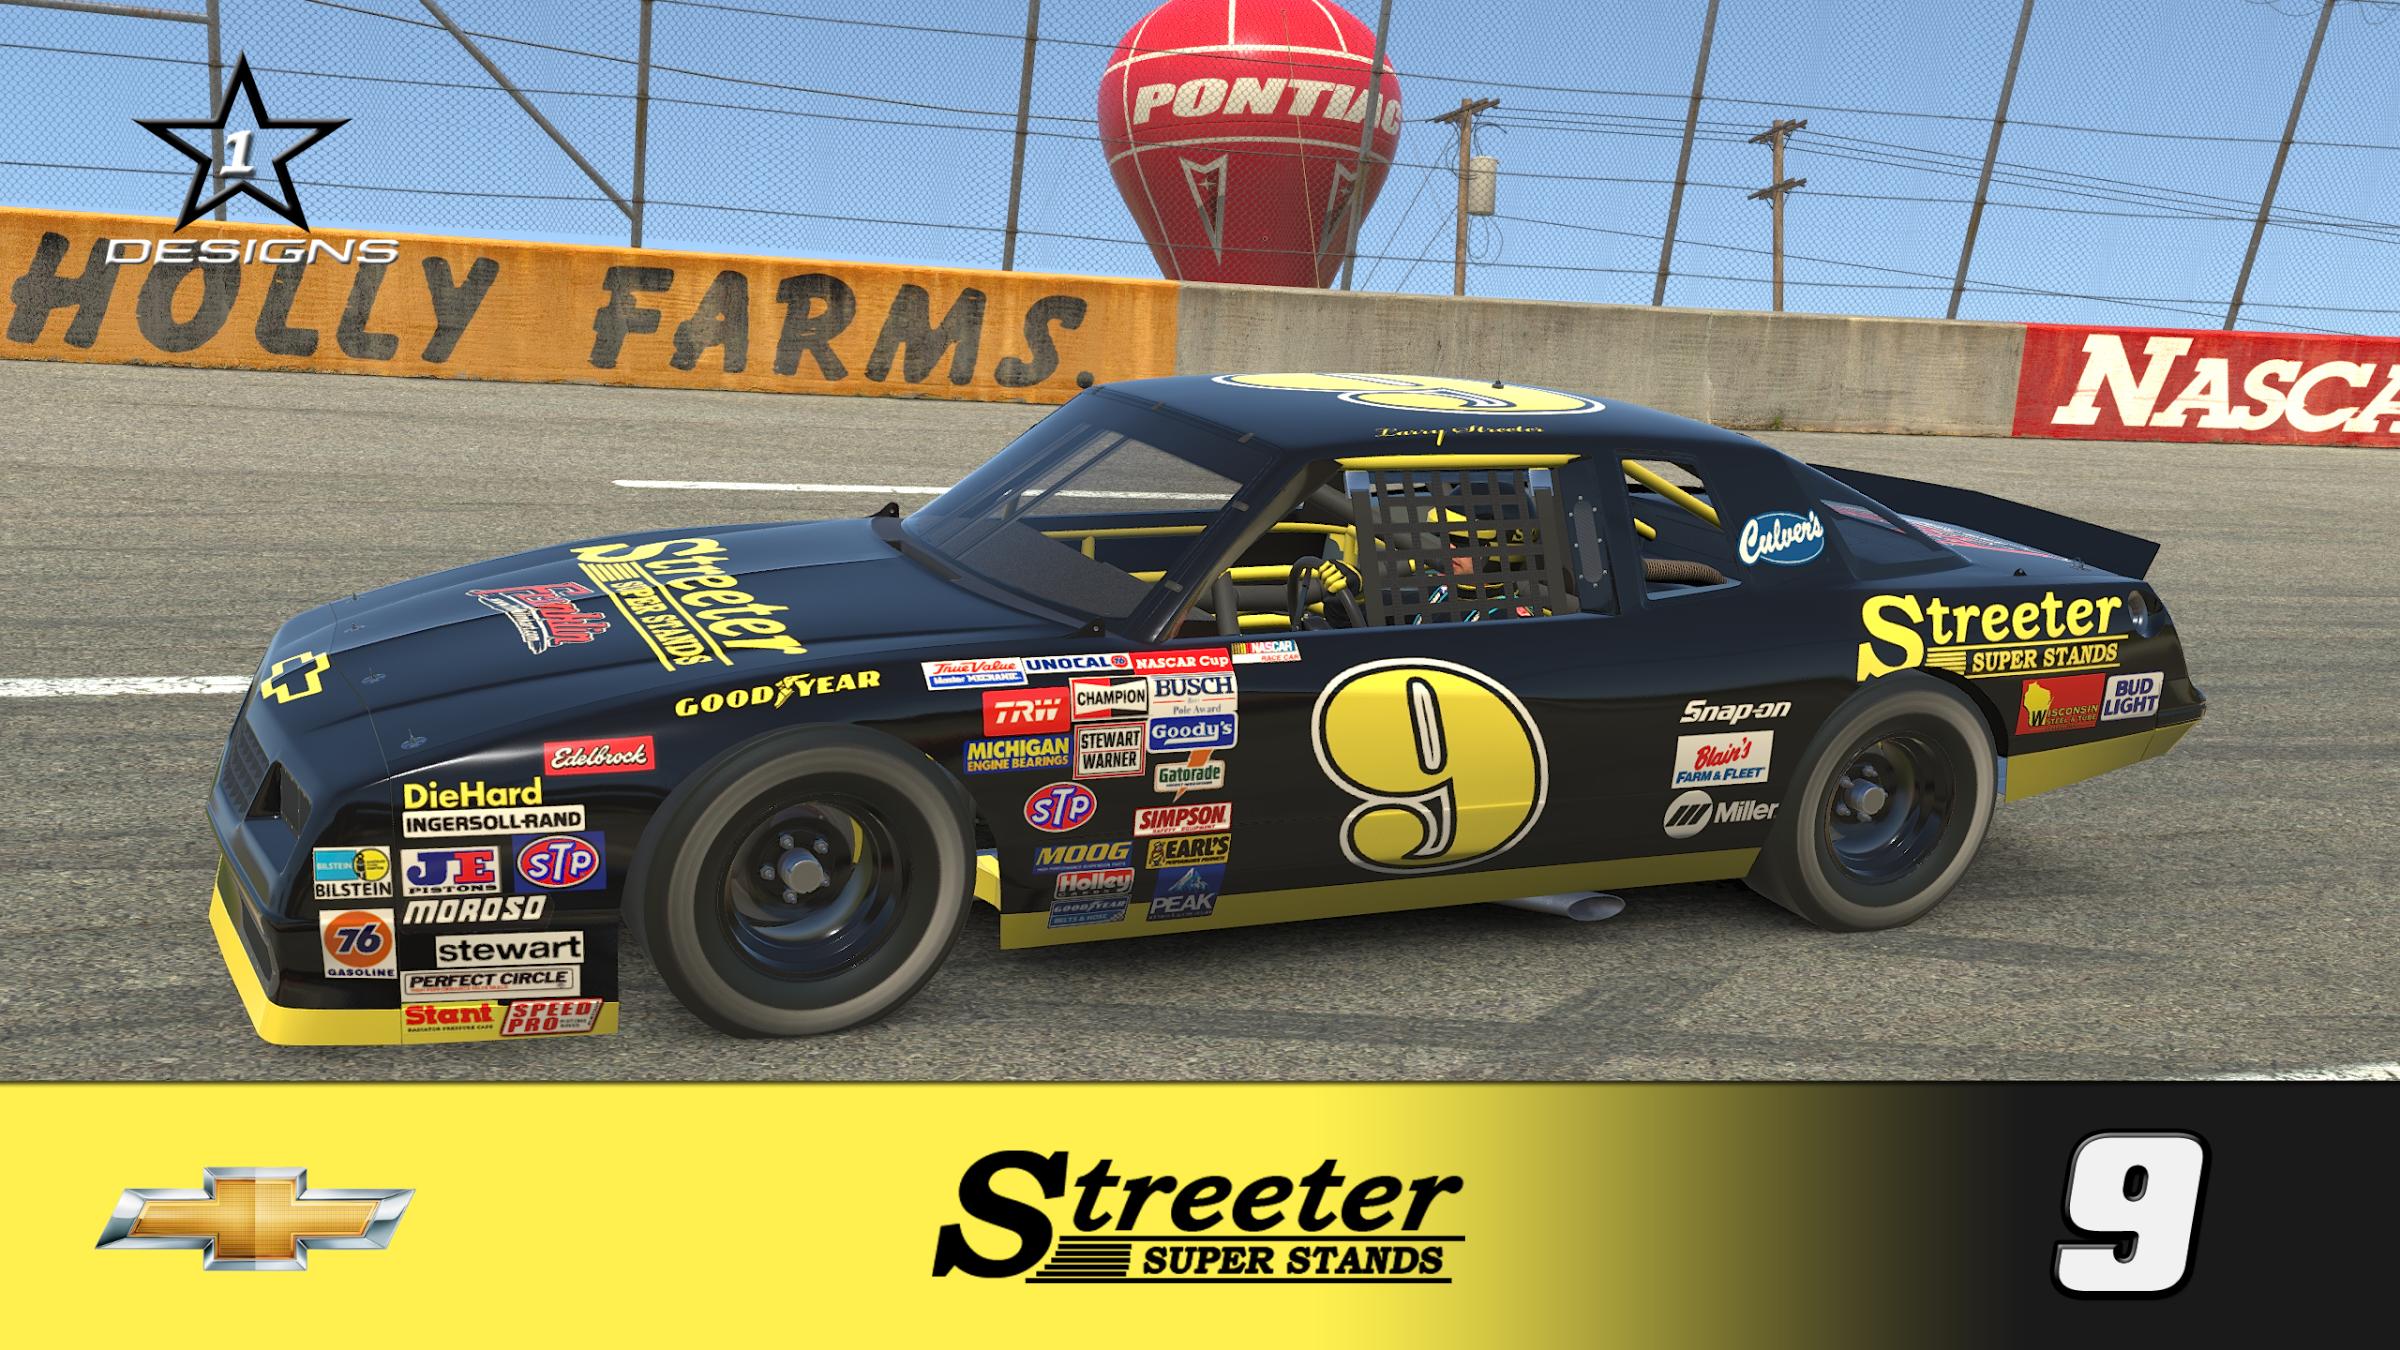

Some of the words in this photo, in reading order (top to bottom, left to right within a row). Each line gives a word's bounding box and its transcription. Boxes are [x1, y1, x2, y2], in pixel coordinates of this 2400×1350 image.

[1133, 77, 1401, 136] PONTIAC
[6, 231, 500, 364] HOLLY
[588, 266, 1095, 389] FARMS.
[1739, 510, 1824, 564] Culver's
[570, 538, 808, 654] Streeter
[610, 580, 668, 615] SUPER
[640, 614, 713, 666] STANDS
[1252, 640, 1294, 652] NASCAR
[1856, 591, 2122, 683] Streeter
[1026, 656, 1111, 671] UNOCAL
[1113, 656, 1126, 665] 76
[1136, 657, 1197, 669] NASCAR
[1199, 656, 1229, 669] Cup
[1972, 647, 2038, 674] SUPER
[2046, 643, 2119, 668] STANDS
[675, 670, 881, 717] GOODYEAR
[1077, 689, 1146, 706] CHAMPION
[1154, 677, 1235, 697] BUSCH
[2115, 678, 2154, 697] BUD
[994, 698, 1061, 724] TRW
[1173, 705, 1191, 714] Pole
[1193, 704, 1222, 713] Award
[1679, 699, 1792, 725] Snap-on
[2031, 704, 2099, 727] WISCONSIN
[2103, 695, 2159, 716] LIGHT
[1081, 731, 1141, 749] STEWART
[1152, 720, 1233, 746] Goody's
[550, 743, 647, 770] Edelbrock
[967, 738, 1069, 761] MICHIGAN
[1083, 751, 1137, 769] WARNER
[1694, 736, 1752, 771] Blain's
[967, 759, 1010, 772] ENGINE
[1012, 755, 1069, 769] BEARINGS
[1159, 765, 1221, 783] Gatorade
[1311, 657, 1549, 875] 9
[1676, 770, 1712, 784] FARM
[1713, 771, 1721, 781] &
[1722, 767, 1764, 781] FLEET
[404, 776, 543, 810] DieHard
[1031, 787, 1091, 827] STP
[1139, 806, 1227, 830] SIMPSON
[1713, 800, 1779, 823] Miller
[406, 810, 582, 833] INGERSOLL-RAND
[1036, 841, 1133, 866] MOOG
[1165, 836, 1230, 859] EARL'S
[406, 849, 497, 886] JE
[528, 842, 592, 881] STP
[315, 881, 393, 898] BILSTEIN
[408, 884, 498, 894] PISTONS
[1059, 872, 1131, 893] Holley
[403, 894, 548, 925] MOROSO
[1150, 892, 1216, 914] PEAK
[334, 923, 384, 954] 76
[439, 936, 582, 963] stewart
[327, 967, 396, 978] GASOLINE
[410, 973, 498, 988] PERFECT
[500, 971, 569, 985] CIRCLE
[405, 1003, 496, 1026] Stant
[513, 1001, 592, 1018] SPEED
[508, 1016, 560, 1033] PRO
